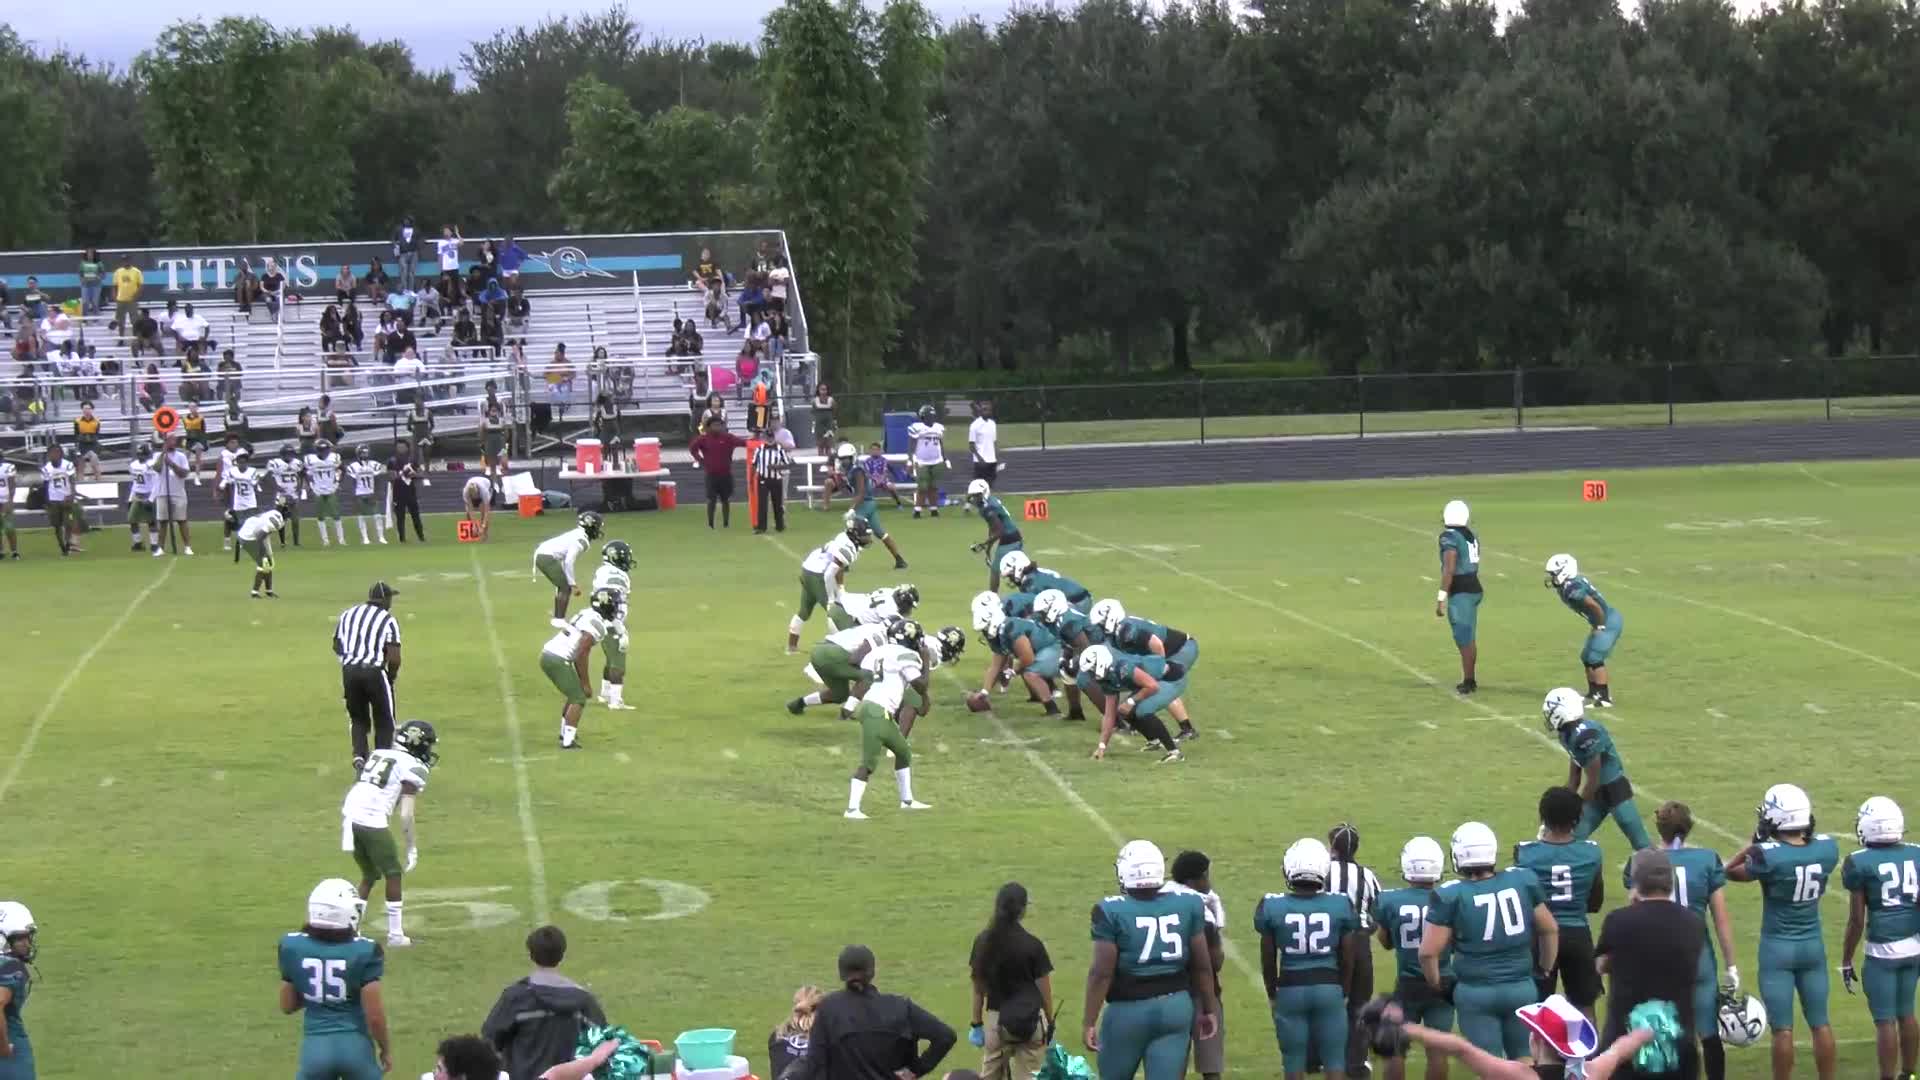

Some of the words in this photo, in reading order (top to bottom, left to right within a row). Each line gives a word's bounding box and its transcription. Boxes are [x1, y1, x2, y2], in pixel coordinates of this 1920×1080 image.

[754, 405, 766, 428] 1
[235, 481, 252, 496] 12
[1586, 483, 1604, 500] 30
[1027, 502, 1047, 518] 40
[1550, 864, 1573, 902] 9
[1669, 866, 1688, 908] 1
[1793, 863, 1822, 902] 16
[1878, 860, 1919, 907] 24
[1284, 912, 1332, 955] 32
[1474, 888, 1526, 942] 70
[1135, 913, 1183, 963] 75
[301, 958, 348, 1004] 35
